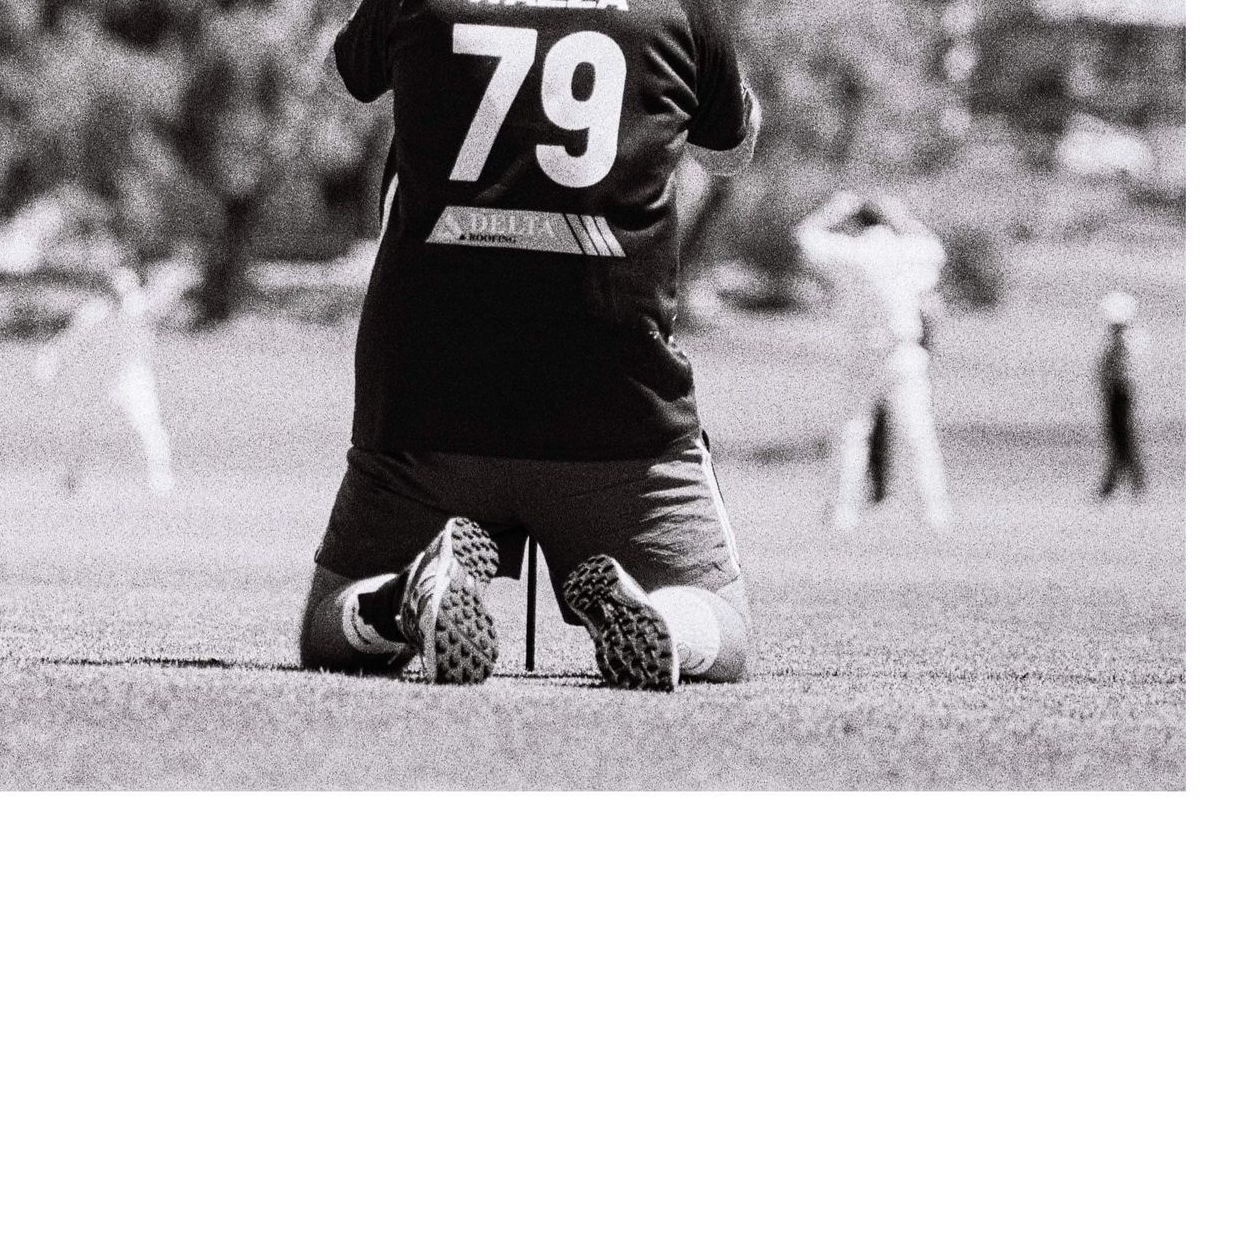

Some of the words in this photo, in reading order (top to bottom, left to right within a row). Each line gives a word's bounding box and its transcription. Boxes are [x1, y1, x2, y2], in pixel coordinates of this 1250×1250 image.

[449, 23, 627, 188] 79
[469, 213, 555, 237] DELTA
[469, 232, 517, 244] ROOFING
